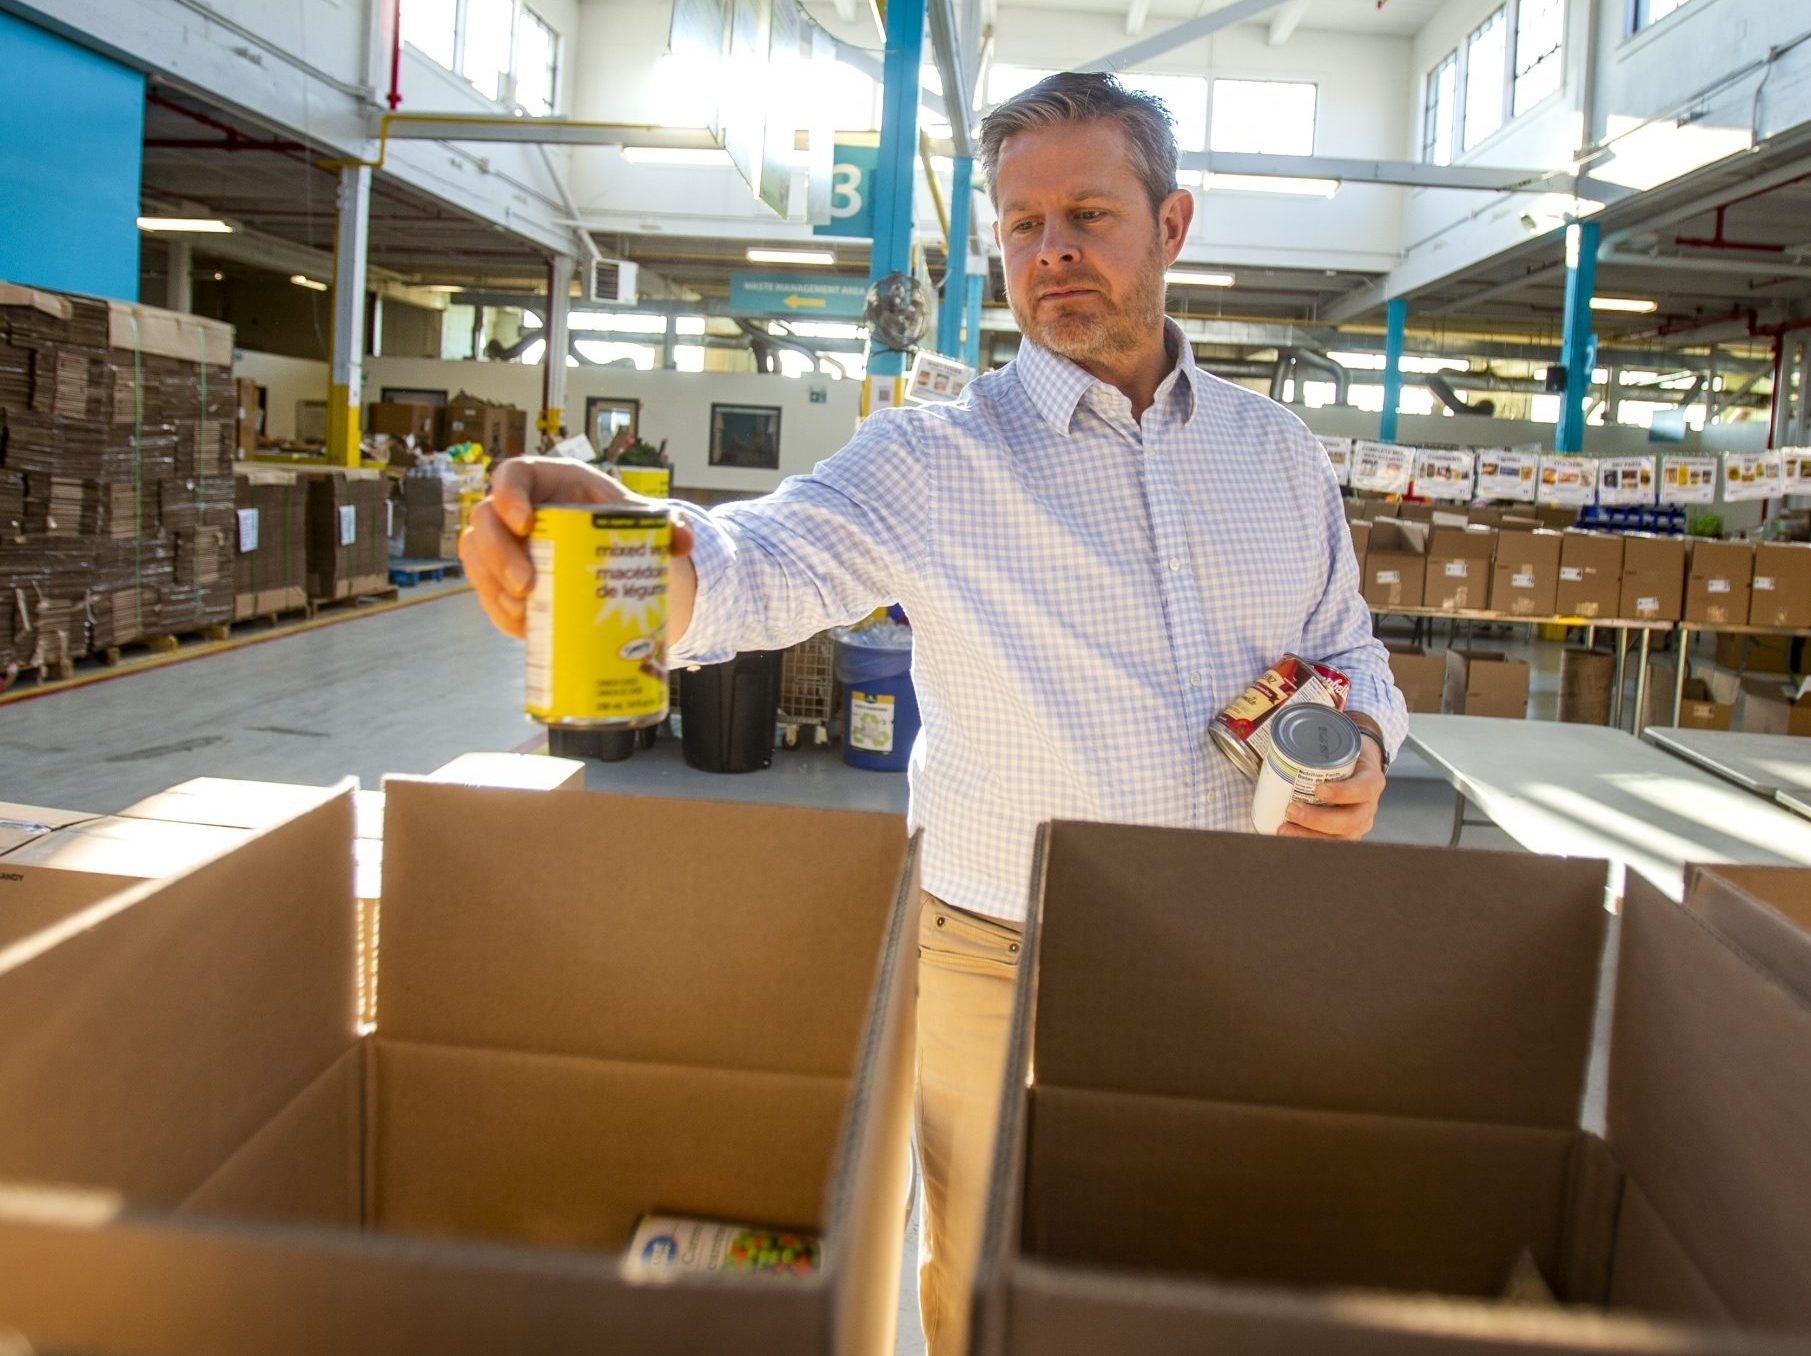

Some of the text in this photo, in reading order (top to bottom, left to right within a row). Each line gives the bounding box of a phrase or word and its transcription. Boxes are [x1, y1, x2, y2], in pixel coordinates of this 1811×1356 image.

[831, 163, 862, 219] 3
[744, 281, 865, 295] WASTE MANAGEMENT AREA
[595, 543, 647, 557] mixed
[595, 584, 618, 598] de
